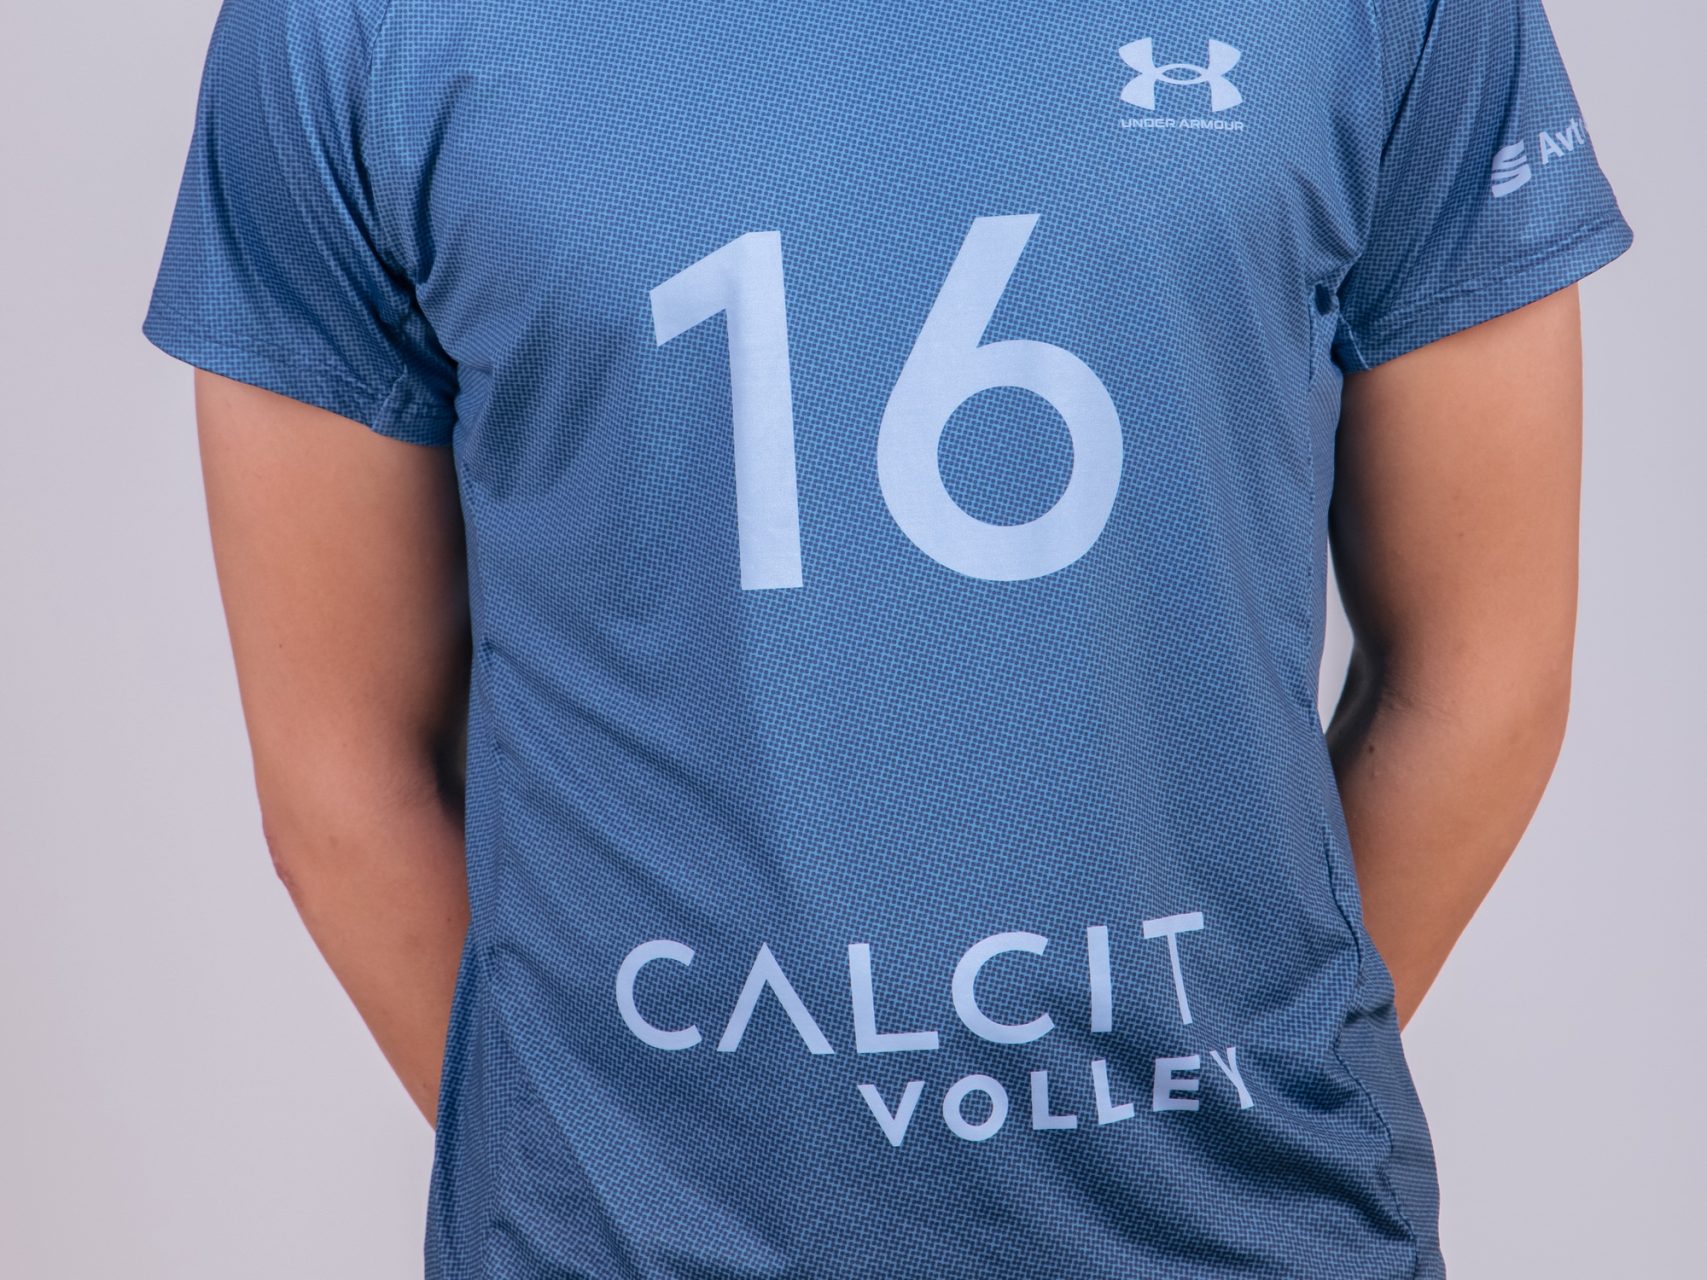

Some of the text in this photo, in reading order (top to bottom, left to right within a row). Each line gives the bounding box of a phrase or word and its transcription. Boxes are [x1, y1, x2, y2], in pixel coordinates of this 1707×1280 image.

[1121, 118, 1244, 131] UNDER ARMOUR
[649, 213, 1124, 590] 16
[615, 911, 1204, 1054] CALCIT
[857, 1047, 1254, 1146] VOLLEY
